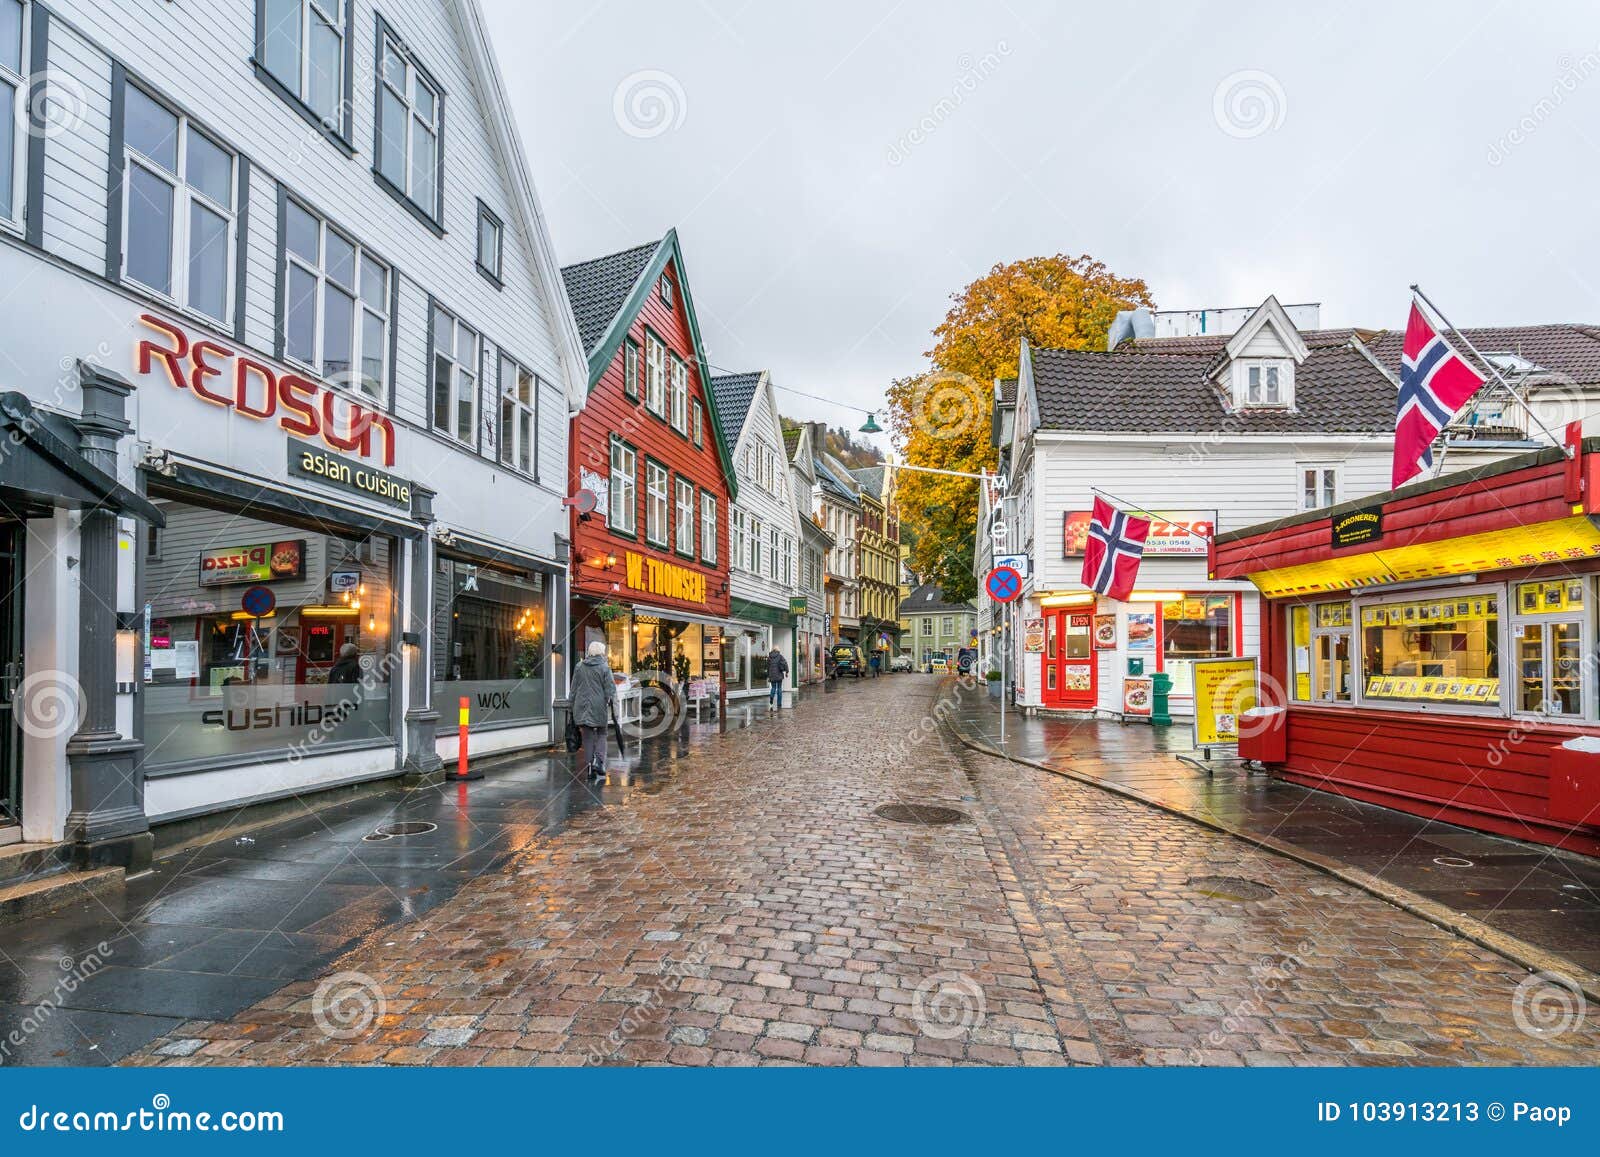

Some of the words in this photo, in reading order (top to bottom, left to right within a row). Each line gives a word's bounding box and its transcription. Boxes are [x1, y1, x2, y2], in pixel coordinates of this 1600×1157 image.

[303, 450, 351, 484] asian
[356, 470, 410, 503] cuisine
[478, 691, 511, 710] WOK
